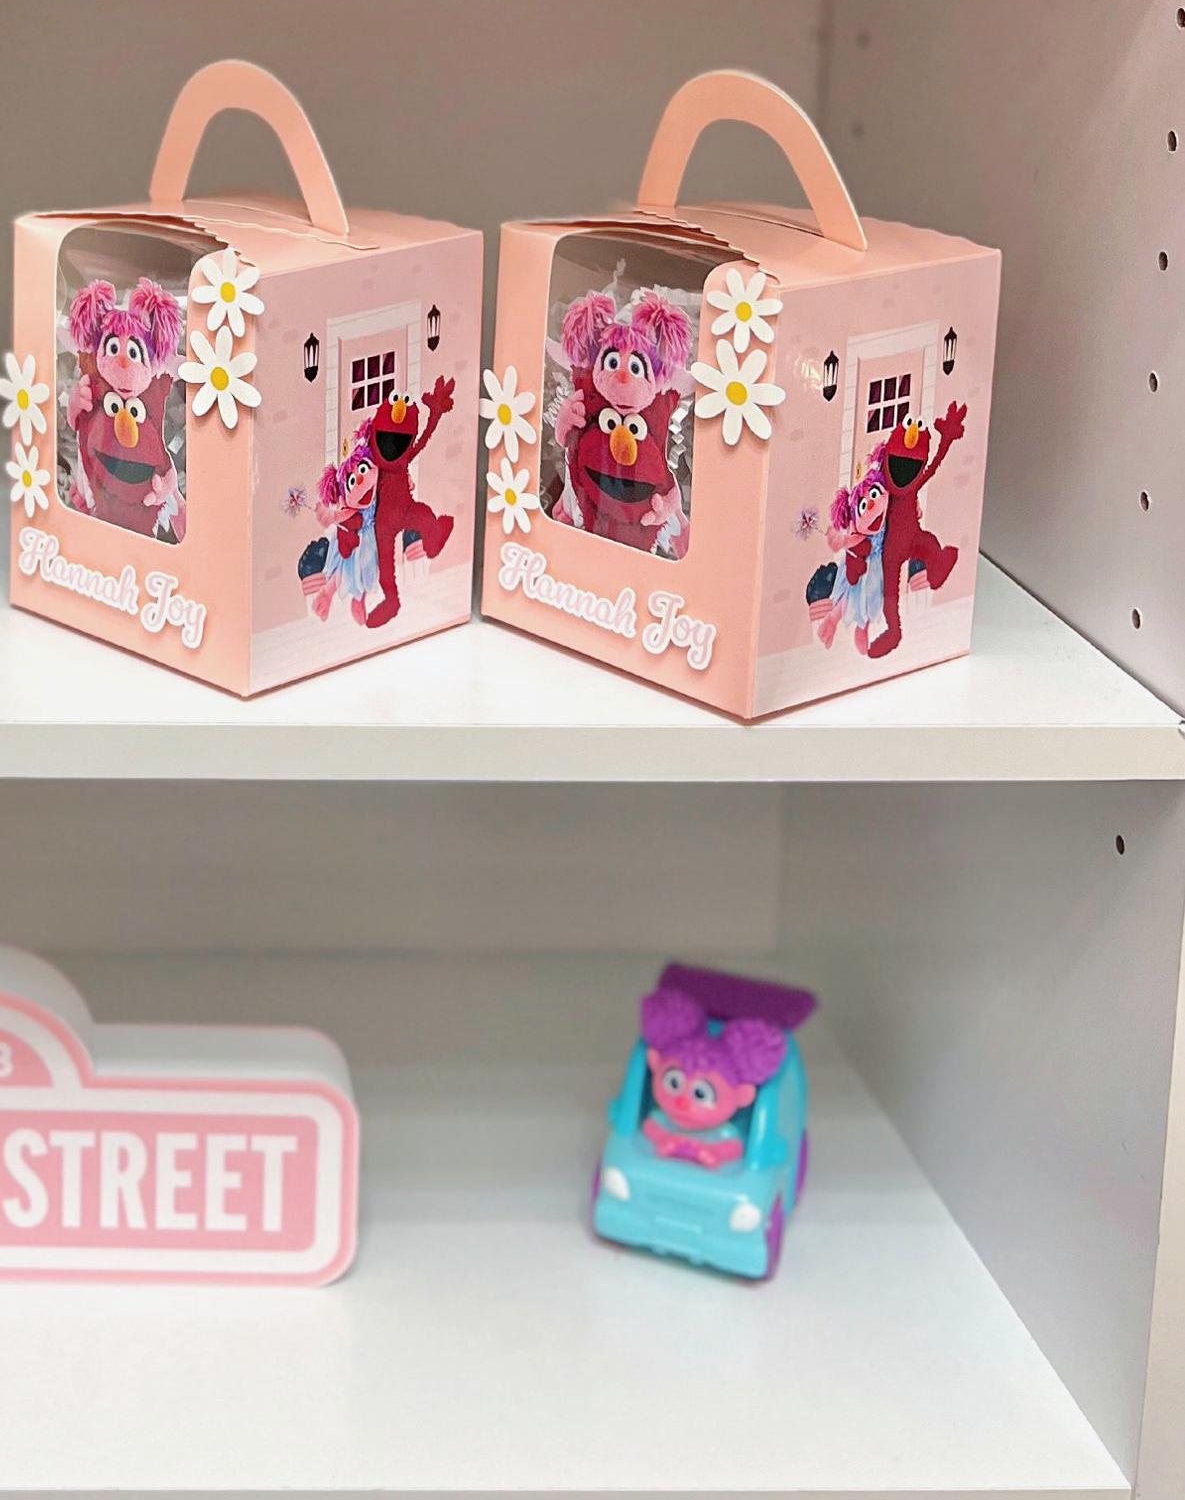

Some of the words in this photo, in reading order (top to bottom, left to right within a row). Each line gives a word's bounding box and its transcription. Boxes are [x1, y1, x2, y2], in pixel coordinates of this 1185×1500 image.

[19, 526, 139, 615] Hannah
[140, 571, 207, 649] Joy
[498, 541, 637, 638] Hannah
[642, 590, 717, 671] Joy
[2, 1129, 297, 1232] STREET
